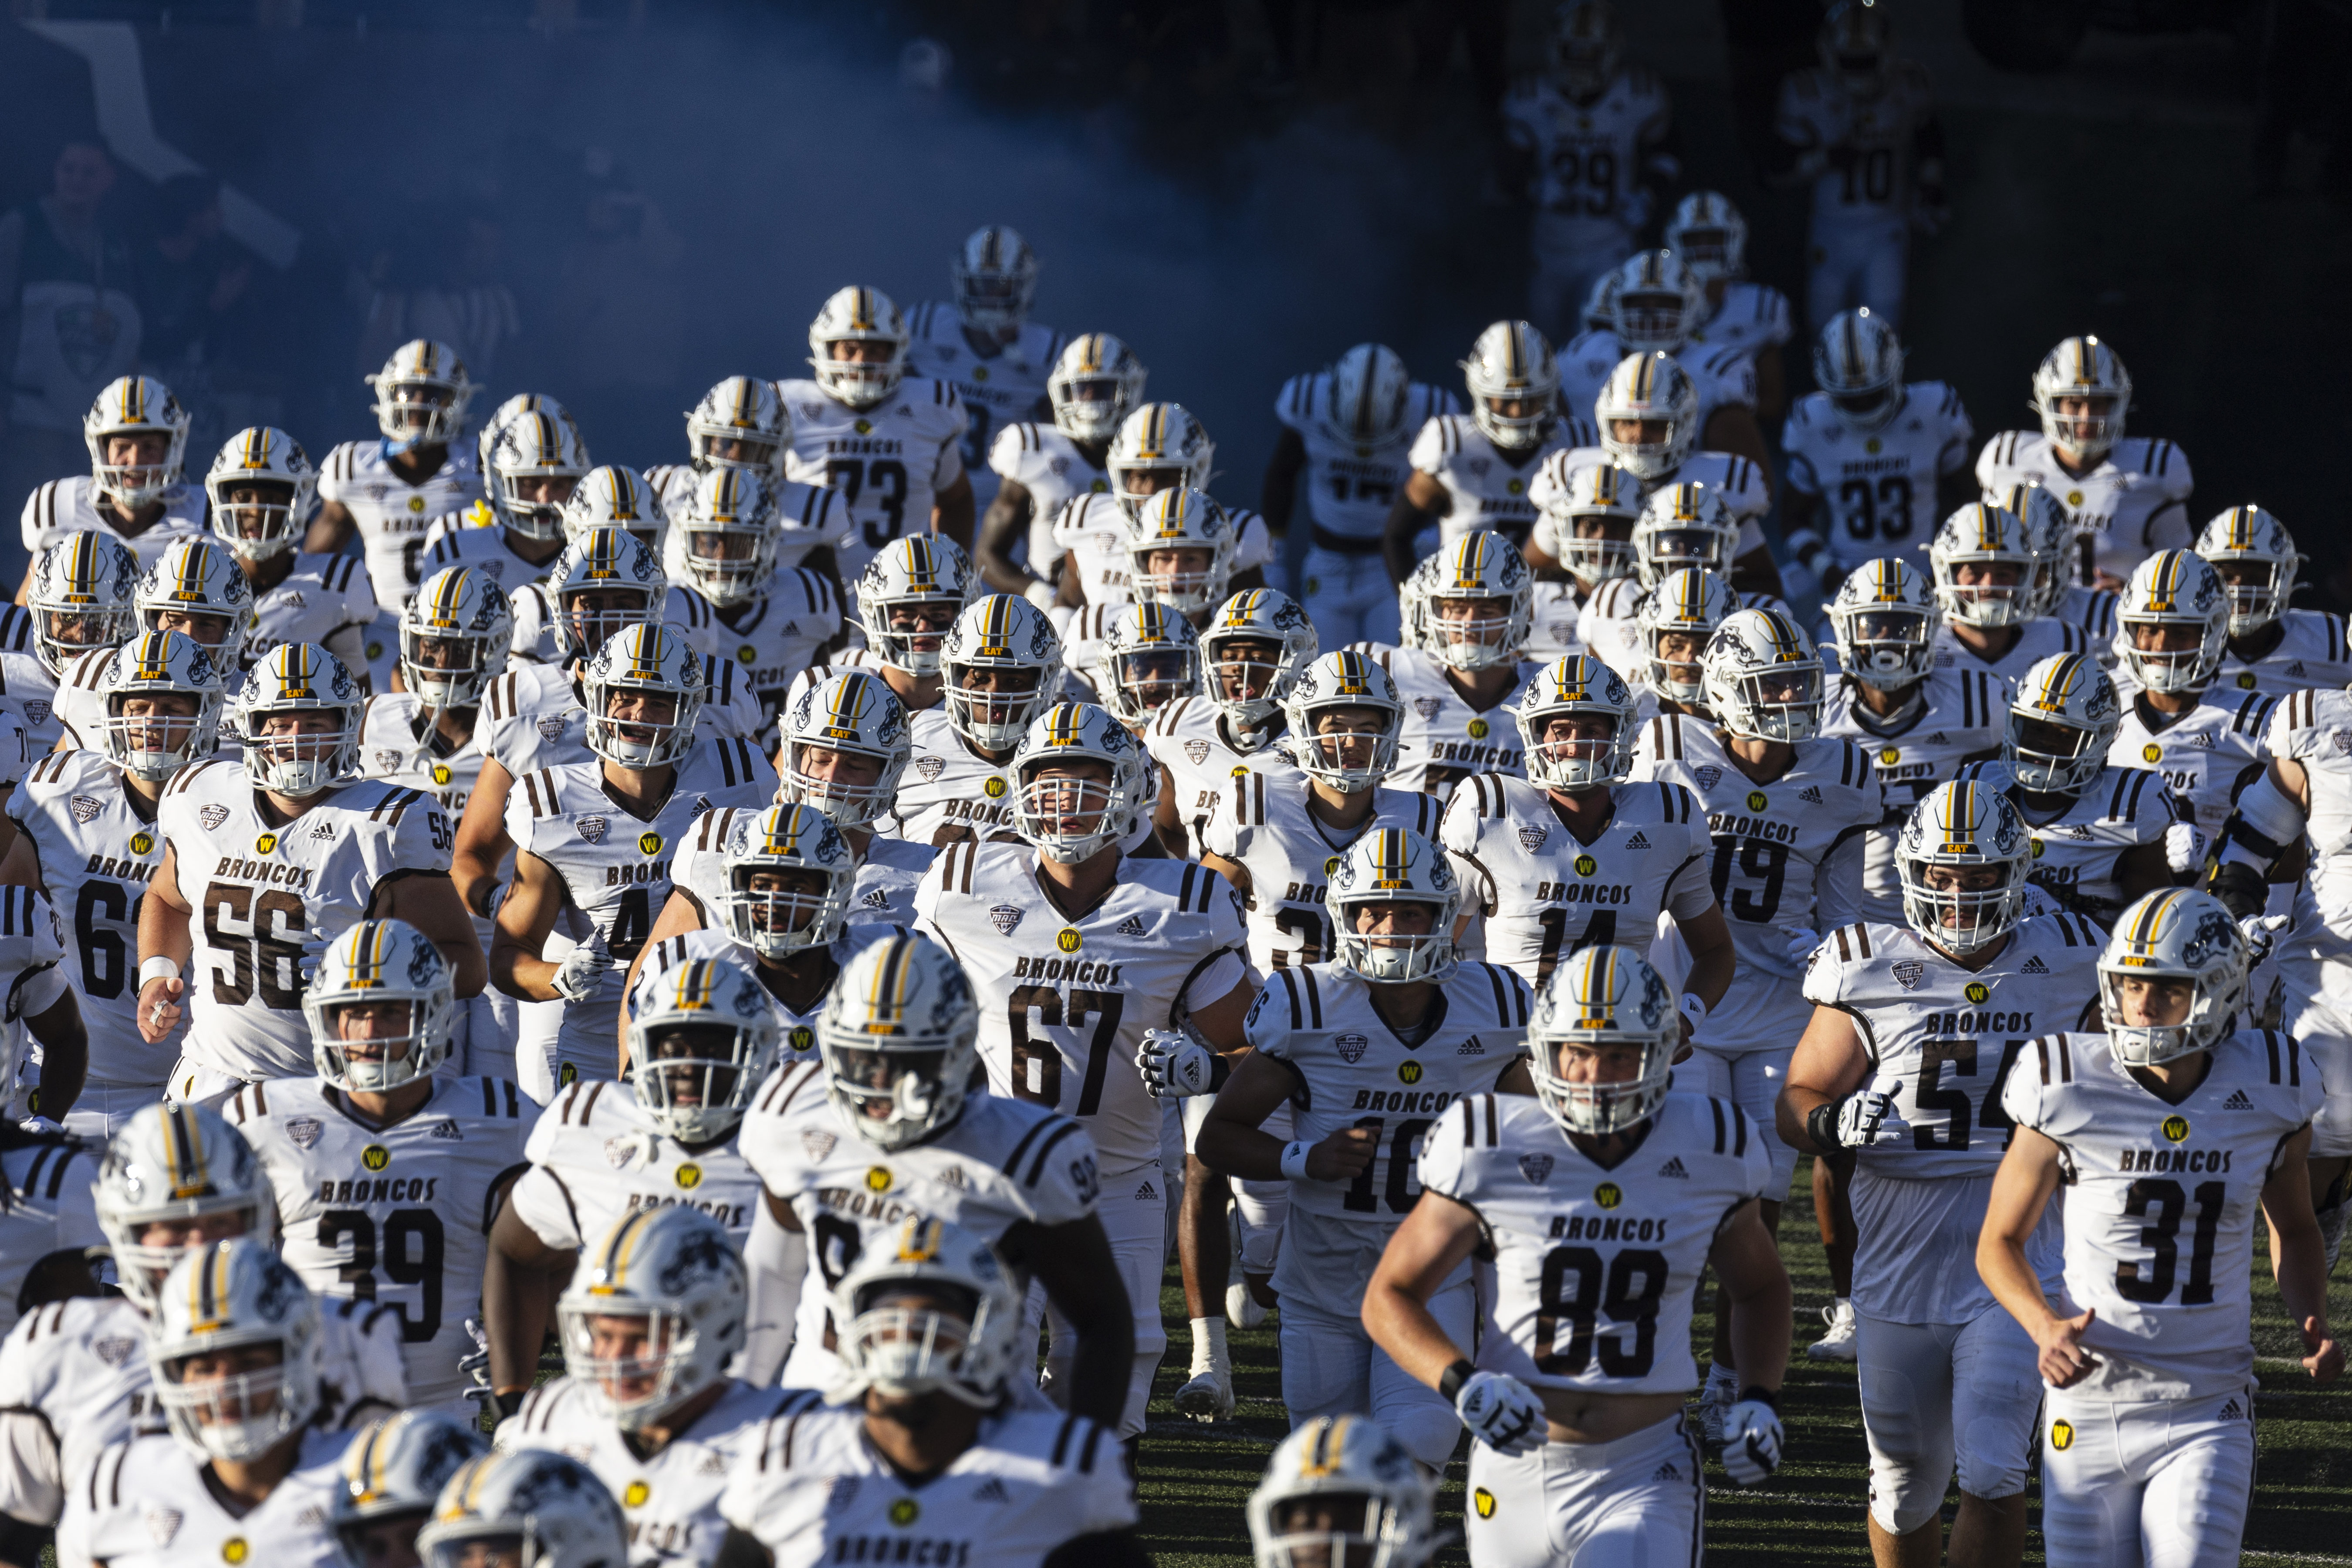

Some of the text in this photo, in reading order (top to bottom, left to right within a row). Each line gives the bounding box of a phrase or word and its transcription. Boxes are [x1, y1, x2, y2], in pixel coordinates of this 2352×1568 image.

[828, 459, 907, 548] 73
[1841, 478, 1913, 540] 33
[178, 592, 198, 600] EAT
[286, 689, 305, 698] EAT
[26, 707, 51, 715] MAC
[2040, 702, 2058, 712] EAT
[830, 729, 851, 739] EAT
[1472, 723, 1484, 736] W
[1185, 747, 1208, 755] MAC
[1431, 742, 1522, 767] BRONCOS
[1883, 750, 1898, 762] W
[1884, 750, 1897, 763] W
[2146, 747, 2159, 761] W
[917, 764, 943, 772] MAC
[436, 768, 449, 783] W
[1144, 763, 1156, 799] 6
[989, 781, 1001, 794] W
[73, 804, 98, 813] MAC
[1751, 795, 1764, 809] W
[201, 812, 226, 821] MAC
[943, 799, 1014, 826] BRONC
[427, 812, 452, 850] 56
[579, 824, 604, 833] MAC
[1709, 813, 1800, 844] BRONCOS
[310, 832, 336, 841] adidas
[1520, 834, 1546, 844] MAC
[135, 837, 149, 852] W
[260, 837, 274, 852] W
[643, 838, 658, 852] W
[768, 847, 789, 855] EAT
[1947, 844, 1968, 853] EAT
[88, 855, 158, 882] BRONC
[214, 857, 313, 888] BRONCOS
[606, 860, 674, 887] BRON
[1579, 860, 1592, 873] W
[1381, 881, 1402, 889] EAT
[1710, 835, 1788, 923] 19
[1535, 881, 1632, 905] BRONCOS
[862, 898, 890, 909] adidas
[1229, 889, 1246, 929] 6
[611, 889, 673, 951] 4
[992, 914, 1018, 923] MAC
[1118, 926, 1146, 936] adidas
[75, 879, 147, 1000] 6
[204, 881, 306, 1010] 56
[1061, 934, 1077, 948] W
[1272, 908, 1335, 970] 2
[2125, 957, 2145, 967] EAT
[1012, 956, 1123, 986] BRONCOS
[1895, 969, 1922, 978] MAC
[350, 979, 372, 989] EAT
[350, 980, 372, 989] EAT
[1968, 987, 1985, 1000] W
[1583, 1019, 1606, 1029] EAT
[1924, 1011, 2034, 1035] BRONCOS
[793, 1032, 809, 1047] W
[1008, 985, 1124, 1116] 67
[1338, 1044, 1366, 1052] MAC
[1457, 1046, 1485, 1055] adidas
[562, 1069, 574, 1082] W
[1403, 1067, 1417, 1081] W
[2223, 1102, 2254, 1111] adidas
[2167, 1122, 2185, 1139] W
[366, 1151, 385, 1167] W
[2118, 1149, 2233, 1173] BRONCOS
[679, 1168, 696, 1184] W
[318, 1178, 438, 1203] BRONCOS
[1600, 1189, 1615, 1203] W
[1549, 1216, 1667, 1242] BRONCOS
[2115, 1178, 2226, 1305] 31
[317, 1208, 445, 1343] 39
[1534, 1246, 1669, 1378] 89
[2054, 1423, 2072, 1448] W
[1476, 1490, 1494, 1517] W
